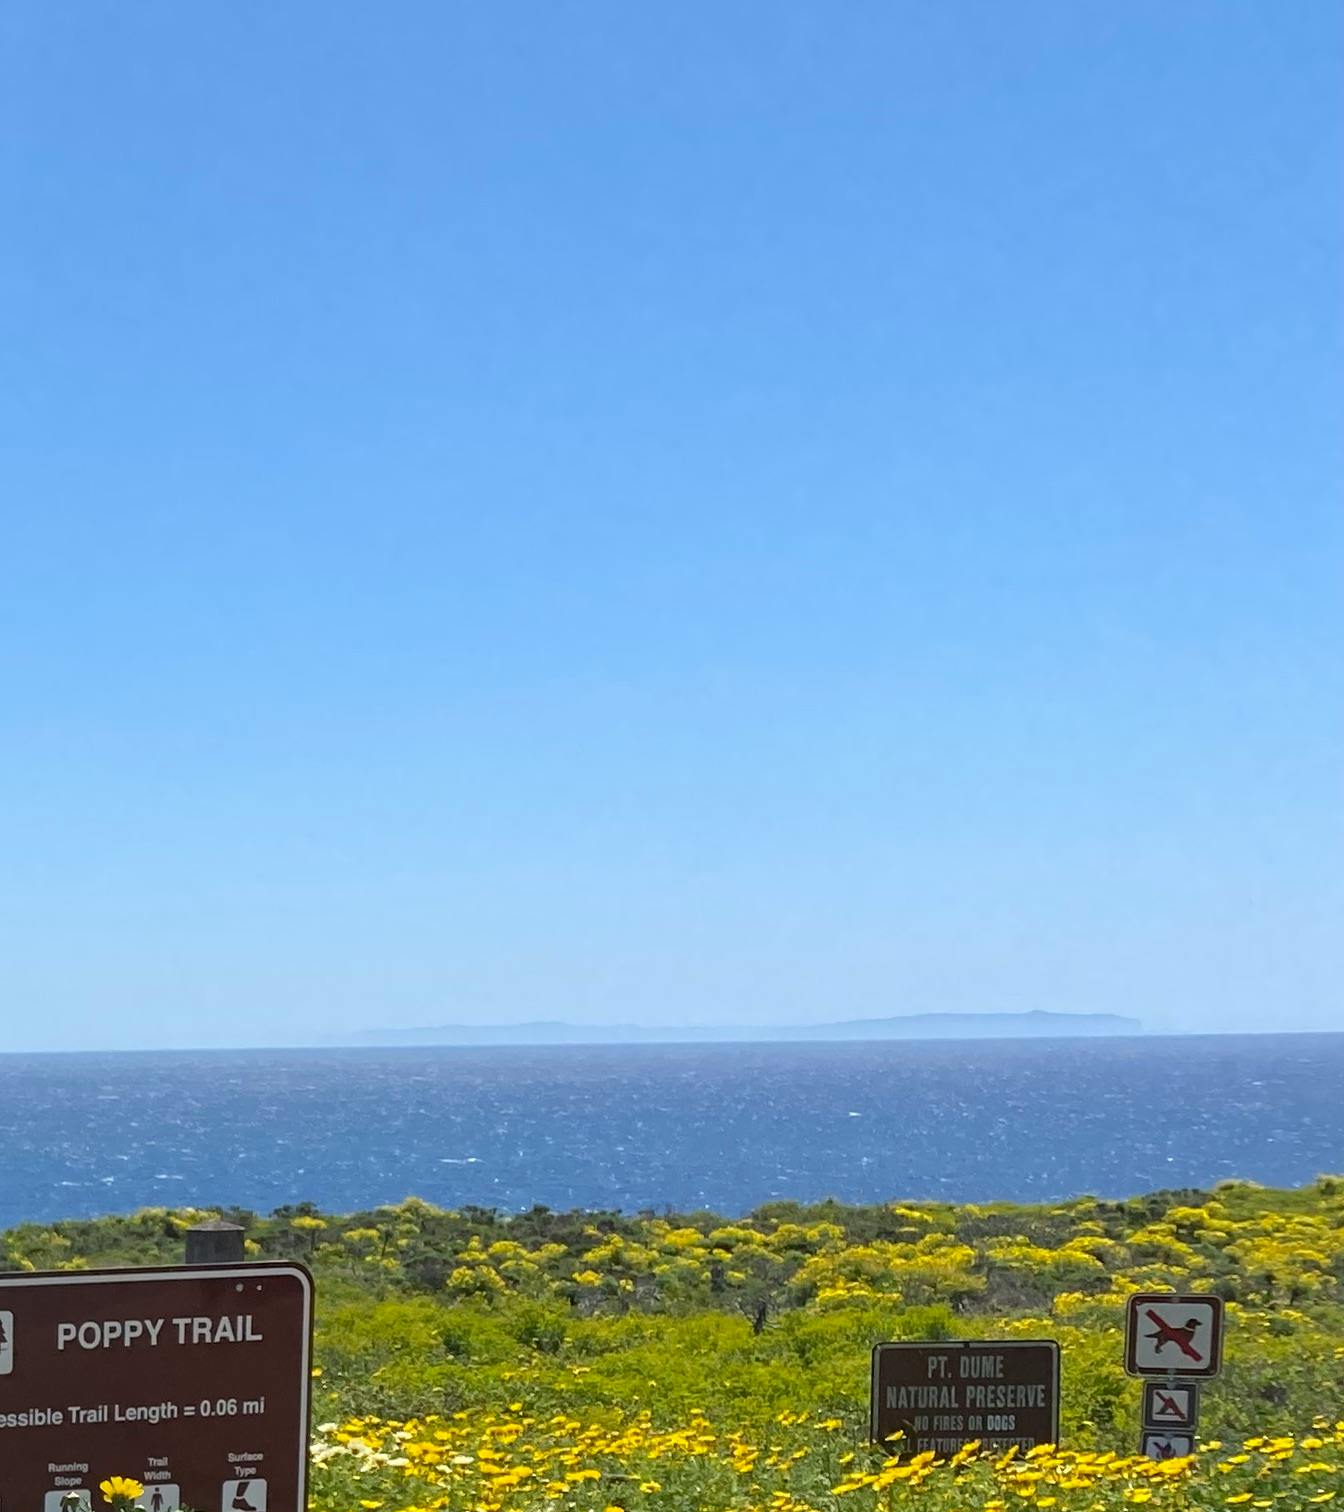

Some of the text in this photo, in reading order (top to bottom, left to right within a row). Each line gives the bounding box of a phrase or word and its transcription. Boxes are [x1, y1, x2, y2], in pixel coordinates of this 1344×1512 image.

[57, 1315, 263, 1350] POPPY TRAIL
[927, 1355, 1005, 1379] PT. DUME
[886, 1384, 1047, 1409] NATURAL PRESERVE
[68, 1403, 108, 1424] Trail
[114, 1400, 178, 1425] Length
[183, 1405, 196, 1416] =
[200, 1399, 238, 1417] 0.06
[243, 1396, 265, 1415] mi
[913, 1414, 1016, 1431] NO FIRES OR DOGS
[147, 1457, 169, 1467] Trail
[228, 1452, 264, 1463] Surface
[48, 1461, 89, 1474] Running
[234, 1465, 257, 1477] Type
[54, 1476, 82, 1487] Slope
[144, 1470, 172, 1481] Width
